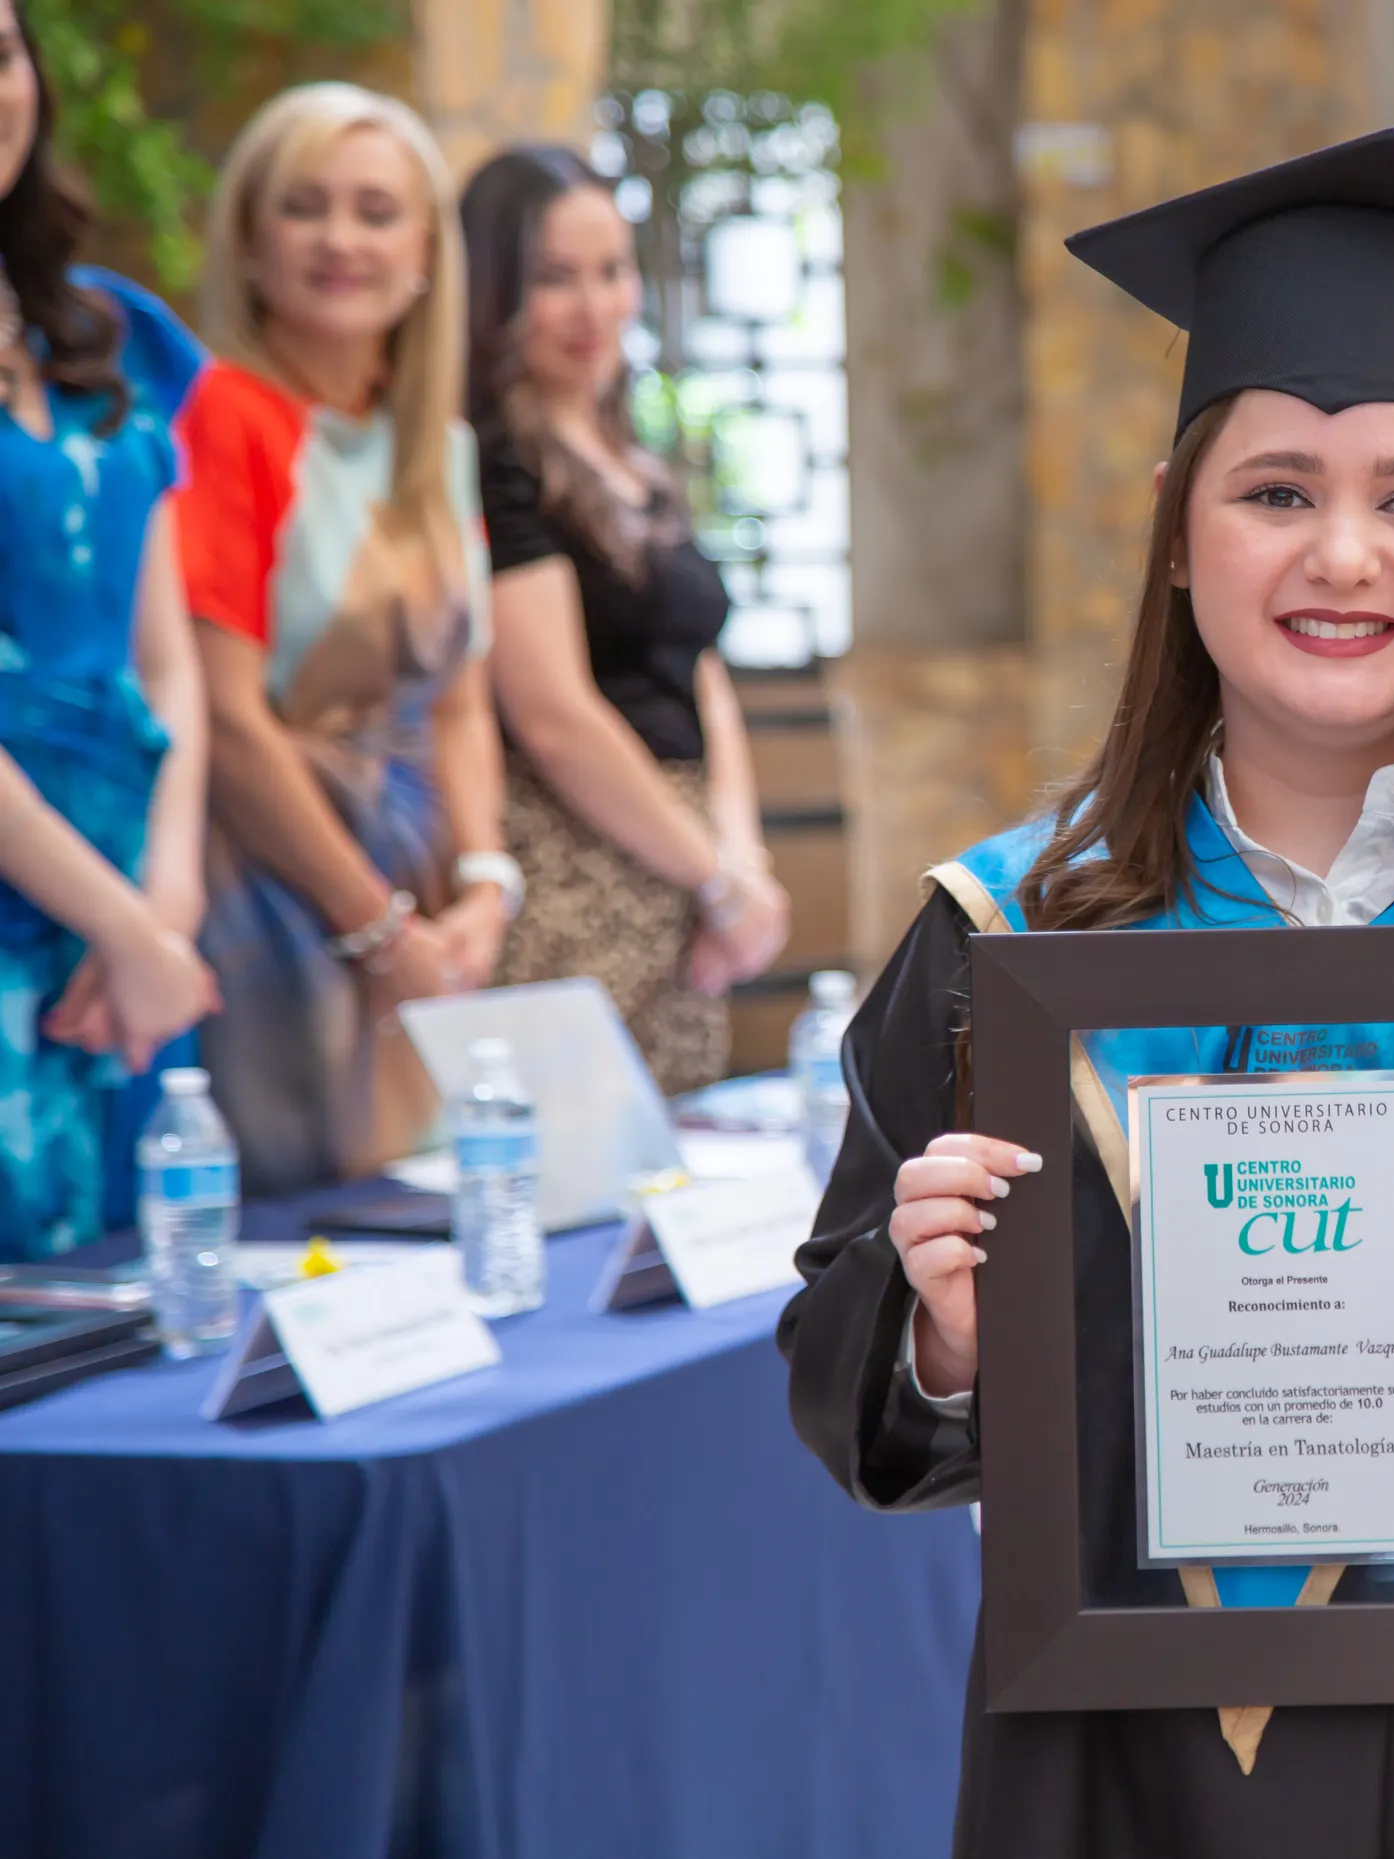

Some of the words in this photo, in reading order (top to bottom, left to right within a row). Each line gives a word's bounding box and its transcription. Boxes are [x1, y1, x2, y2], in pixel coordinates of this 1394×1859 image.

[1257, 1028, 1328, 1046] CENTRO
[1255, 1041, 1379, 1064] UNIVERSITARIO
[1166, 1106, 1238, 1122] CENTRO
[1247, 1102, 1388, 1120] UNIVERSITARIO
[1227, 1121, 1249, 1135] DE
[1259, 1119, 1334, 1134] SONORA
[1237, 1160, 1302, 1175] CENTRO
[1237, 1176, 1356, 1192] UNIVERSITARIO
[1237, 1195, 1258, 1209] DE
[1263, 1194, 1329, 1208] SONORA
[1238, 1197, 1363, 1256] cut
[1241, 1277, 1273, 1287] Otorga
[1276, 1275, 1284, 1285] el
[1287, 1275, 1328, 1285] Presente
[1228, 1299, 1331, 1312] Reconocimiento
[1334, 1301, 1345, 1310] a:
[1164, 1345, 1194, 1362] Ana
[1198, 1341, 1267, 1364] Guadalupe
[1270, 1342, 1349, 1357] Bustamante
[1170, 1389, 1188, 1401] Por
[1191, 1387, 1222, 1400] haber
[1282, 1384, 1384, 1398] satisfactoriamente
[1196, 1401, 1241, 1414] estudios
[1244, 1402, 1264, 1413] con
[1267, 1402, 1281, 1412] un
[1284, 1399, 1336, 1414] promedio
[1339, 1398, 1353, 1410] de
[1358, 1397, 1383, 1409] 10.0
[1242, 1415, 1256, 1426] en
[1259, 1413, 1269, 1425] la
[1272, 1414, 1312, 1425] carrera
[1315, 1412, 1333, 1425] de:
[1185, 1440, 1262, 1459] Maestría
[1269, 1444, 1288, 1456] en
[1253, 1478, 1329, 1493] Generación
[1276, 1492, 1311, 1507] 2024
[1244, 1524, 1299, 1535] Hermosillo,
[1303, 1522, 1341, 1533] Sonora.
